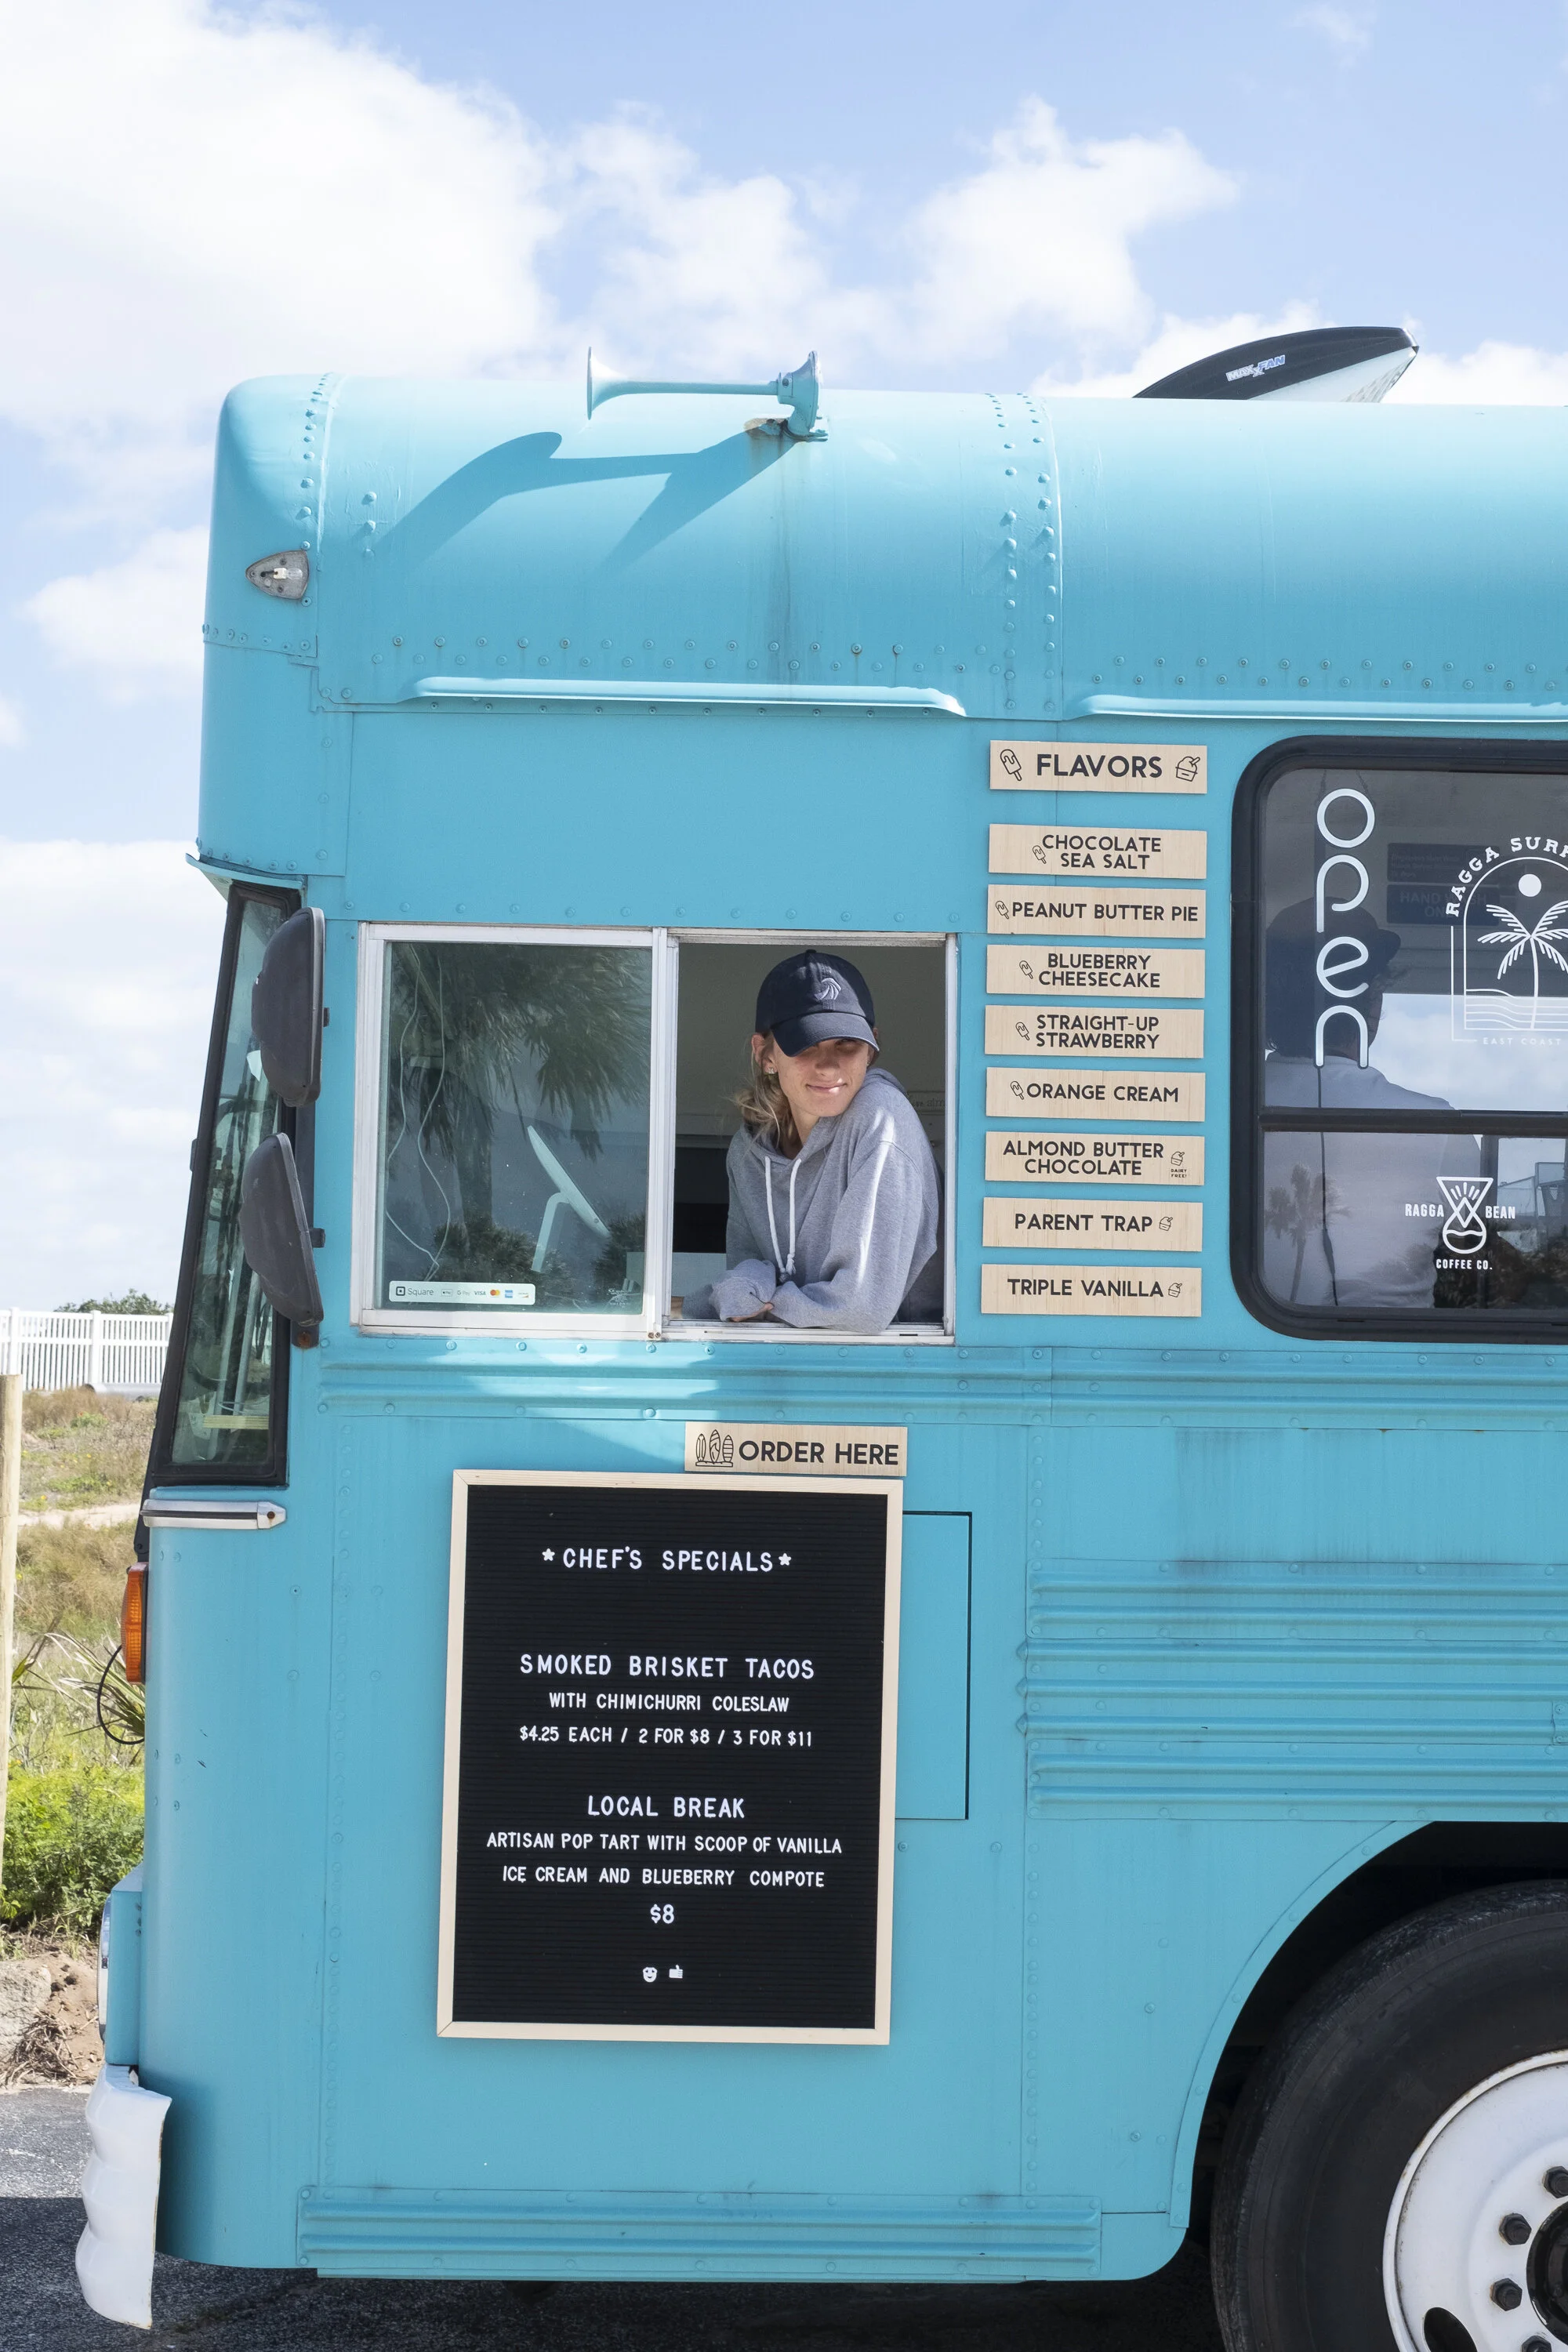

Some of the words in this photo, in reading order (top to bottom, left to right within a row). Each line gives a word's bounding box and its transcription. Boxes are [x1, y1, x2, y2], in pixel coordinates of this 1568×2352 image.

[1037, 754, 1162, 778] FLAVORS
[1042, 834, 1161, 852] CHOCOLATE
[1061, 853, 1094, 868] SEA
[1103, 855, 1149, 869] SALT
[1446, 847, 1500, 917] RAGGA
[1013, 902, 1087, 918] PEANUT
[1094, 905, 1164, 920] BUTTER
[1172, 906, 1198, 921] PIE
[1316, 789, 1375, 1067] open
[1048, 953, 1151, 970] BLUEBERRY
[1039, 971, 1160, 987] CHEESECAKE
[1037, 1014, 1159, 1031] STRAIGHT-UP
[1036, 1033, 1160, 1049] STRAWBERRY
[1027, 1083, 1105, 1100] ORANGE
[1114, 1086, 1178, 1102] CREAM
[1004, 1141, 1085, 1156] ALMOND
[1094, 1142, 1163, 1158] BUTTER
[1025, 1159, 1142, 1175] CHOCOLATE
[1405, 1203, 1444, 1217] RAGGA
[1485, 1205, 1515, 1219] BEAN
[1015, 1214, 1093, 1230] PARENT
[1102, 1215, 1152, 1232] TRAP
[1436, 1259, 1472, 1269] COFFEE
[1477, 1260, 1492, 1269] CO.
[408, 1287, 434, 1297] Square
[1007, 1279, 1072, 1295] TRIPLE
[1081, 1280, 1163, 1297] VANILLA
[739, 1441, 824, 1463] ORDER
[836, 1443, 898, 1465] HERE
[564, 1546, 641, 1569] CHEF'S
[662, 1551, 772, 1572] SPECIALS
[521, 1654, 611, 1675] SMOKED
[630, 1656, 728, 1677] BRISKET
[746, 1658, 814, 1679] TACOS
[550, 1693, 586, 1708] WITH
[597, 1693, 700, 1710] CHIMICHURRI
[713, 1696, 789, 1711] COLESLAW
[521, 1726, 559, 1741] $4.25
[569, 1727, 612, 1742] EACH
[621, 1728, 627, 1743] /
[639, 1729, 648, 1744] 2
[655, 1728, 684, 1743] FOR
[690, 1729, 710, 1744] $8
[718, 1730, 724, 1744] /
[734, 1730, 742, 1744] 3
[750, 1730, 781, 1745] FOR
[788, 1731, 811, 1746] $11
[588, 1795, 658, 1816] LOCAL
[674, 1797, 744, 1818] BREAK
[487, 1832, 554, 1848] ARTISAN
[561, 1833, 593, 1849] POP
[600, 1835, 640, 1849] TART
[648, 1835, 685, 1850] WITH
[695, 1836, 747, 1851] SCOOP
[753, 1837, 771, 1852] OF
[777, 1838, 841, 1853] VANILLA
[503, 1866, 526, 1882] ICE
[535, 1867, 586, 1882] CREAM
[599, 1868, 630, 1883] AND
[643, 1869, 735, 1885] BLUEBERRY
[750, 1871, 824, 1887] COMPOTE
[651, 1904, 674, 1924] $8
